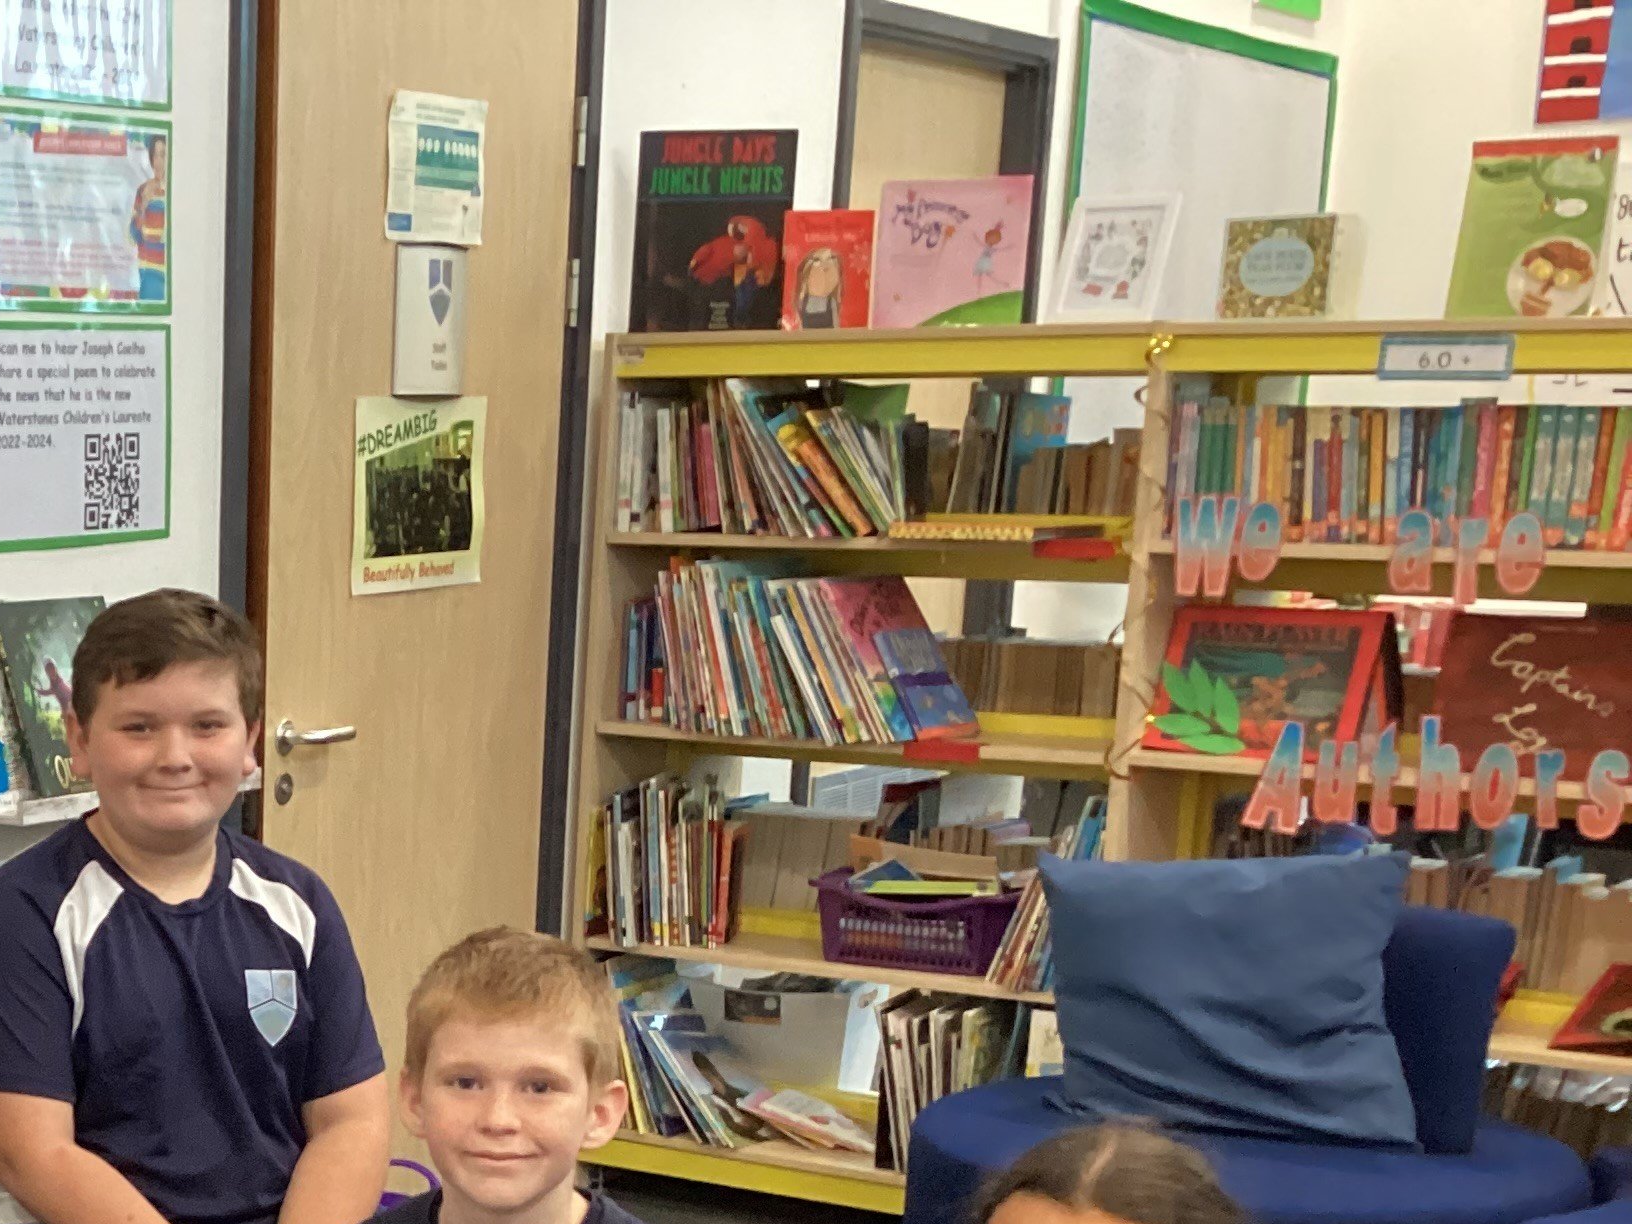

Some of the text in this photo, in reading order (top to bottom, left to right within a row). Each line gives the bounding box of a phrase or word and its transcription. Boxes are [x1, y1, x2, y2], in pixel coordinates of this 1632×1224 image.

[650, 164, 785, 195] JUNGLE NIGHTS
[22, 345, 37, 356] me
[41, 341, 51, 356] to
[55, 341, 78, 356] hear
[82, 341, 114, 359] Joseph
[117, 341, 146, 356] Coelho
[26, 368, 33, 379] a
[37, 364, 69, 382] special
[73, 367, 98, 381] poem
[102, 365, 111, 379] to
[114, 366, 156, 379] celebrate
[16, 390, 40, 402] news
[45, 387, 65, 402] that
[69, 388, 81, 402] he
[85, 389, 93, 401] is
[96, 388, 112, 402] the
[115, 390, 132, 402] new
[63, 410, 110, 425] Children's
[112, 410, 152, 424] Laureate
[357, 409, 438, 457] #DREAMBIG
[1174, 495, 1548, 606] We are
[363, 561, 416, 584] Beautifully
[1240, 714, 1632, 841] Authors
